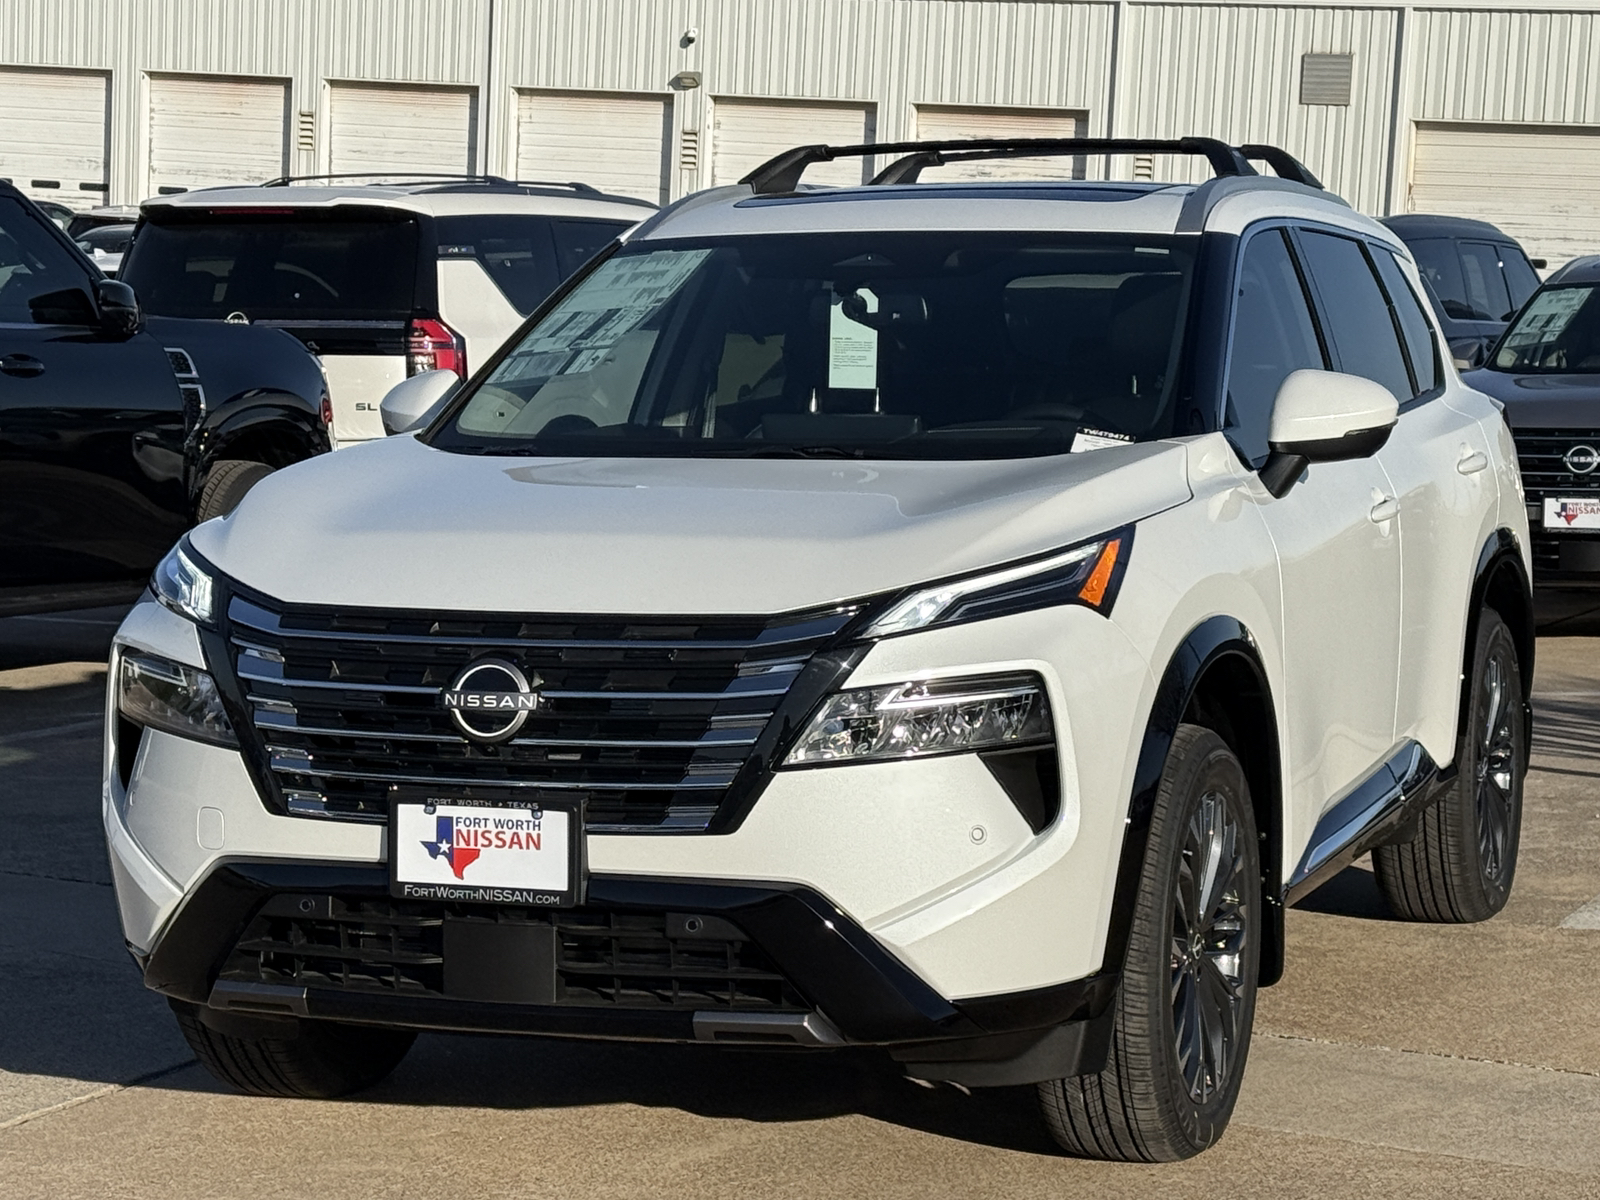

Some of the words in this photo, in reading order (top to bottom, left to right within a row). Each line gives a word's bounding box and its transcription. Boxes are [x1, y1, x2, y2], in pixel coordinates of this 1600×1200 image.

[355, 403, 378, 411] SL
[445, 693, 535, 708] NISSAN
[427, 797, 452, 805] FORT
[456, 798, 492, 807] WORTH
[507, 801, 539, 810] TEXAS
[455, 816, 490, 829] FORT
[493, 818, 541, 831] WORTH
[455, 828, 541, 851] NISSAN
[404, 884, 560, 905] FORTWORTHNISSAN.COM
